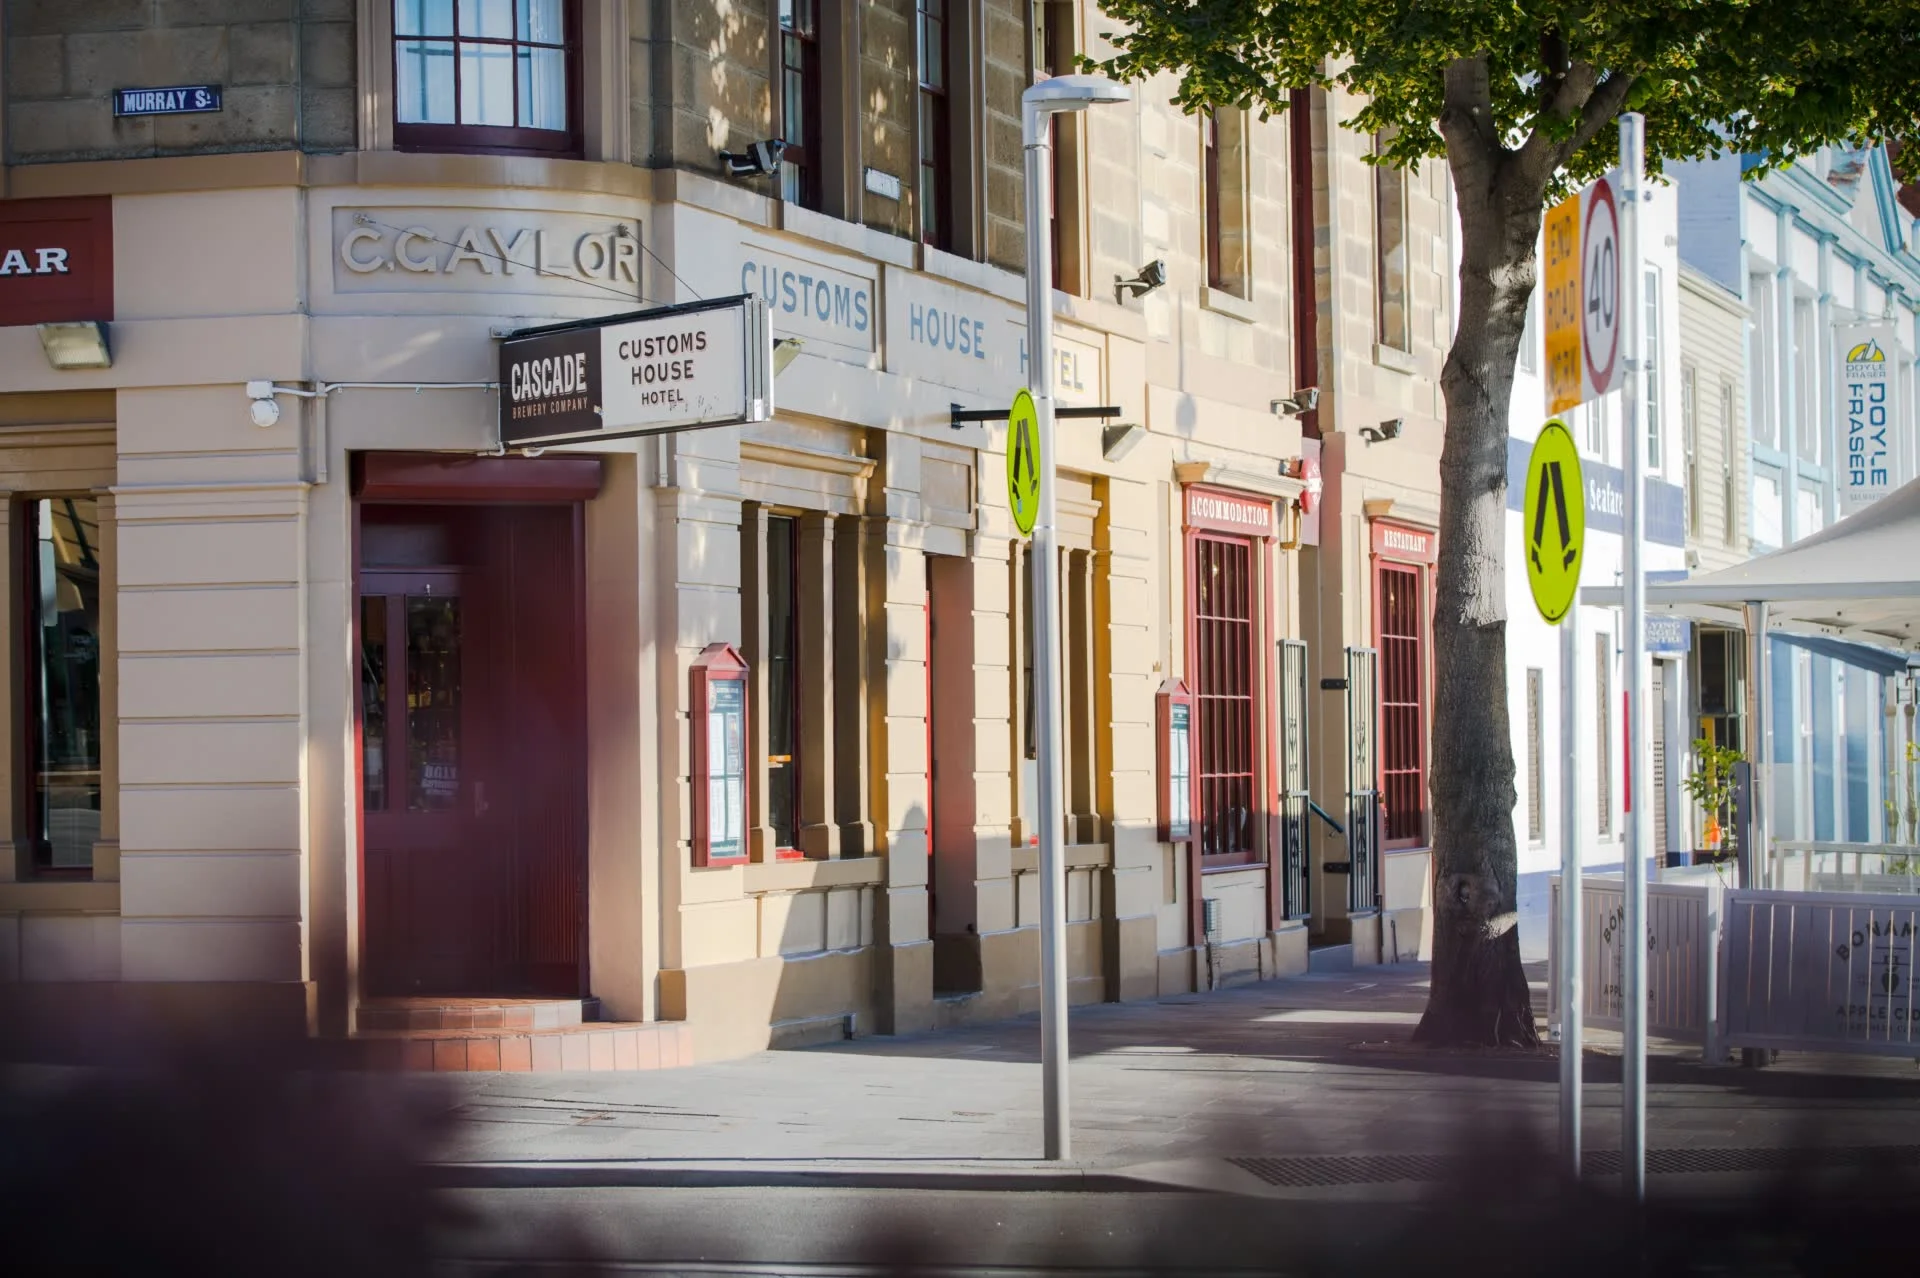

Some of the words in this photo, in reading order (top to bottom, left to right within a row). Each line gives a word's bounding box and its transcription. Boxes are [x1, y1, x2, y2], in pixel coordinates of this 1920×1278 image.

[124, 90, 187, 112] MURRAY
[0, 247, 70, 275] AR
[1588, 235, 1613, 333] 40
[741, 261, 868, 332] CUSTOMS
[911, 303, 985, 359] HOUSE
[1548, 279, 1576, 334] ROAD
[618, 331, 707, 360] CUSTOMS
[511, 352, 587, 402] CASCADE
[631, 359, 694, 386] HOUSE
[512, 402, 547, 420] BREWERY
[550, 397, 588, 414] COMPANY
[641, 388, 684, 406] HOTEL
[1848, 383, 1865, 486] FRASER
[1869, 382, 1887, 486] DOYLE
[1190, 496, 1269, 527] ACCOMMODATION
[1383, 528, 1427, 553] RESTAURANT
